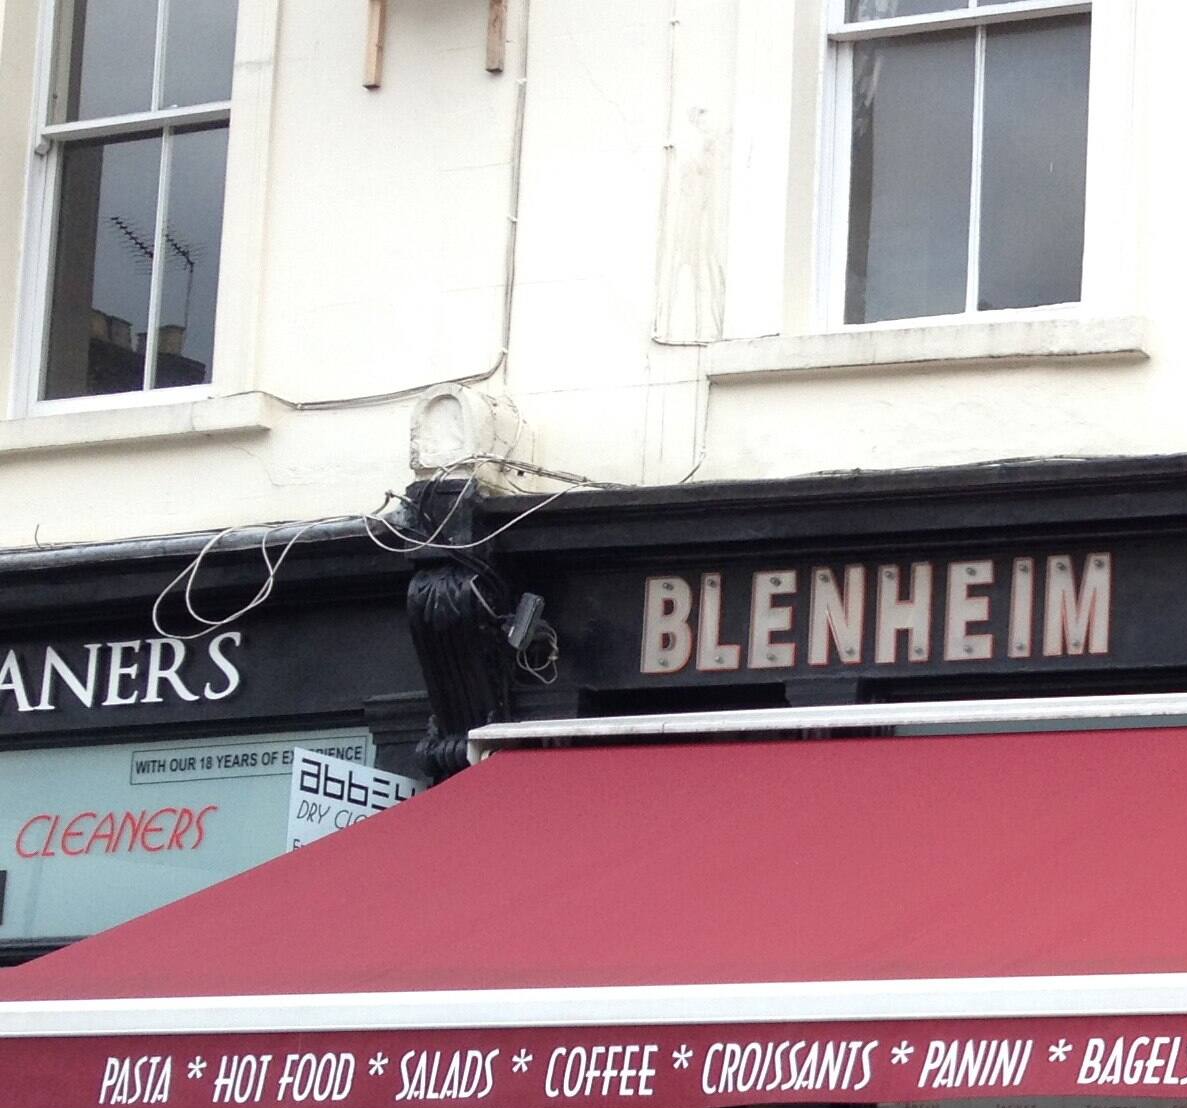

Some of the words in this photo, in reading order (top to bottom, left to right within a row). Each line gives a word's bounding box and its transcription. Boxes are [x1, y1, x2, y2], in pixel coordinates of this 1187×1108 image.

[640, 551, 1112, 673] BLENHEIM
[0, 631, 241, 712] ANERS
[136, 760, 166, 775] WITH
[169, 757, 196, 771] OUR
[200, 756, 213, 770] 18
[217, 754, 258, 769] YEARS
[261, 752, 278, 767] OF
[15, 805, 218, 858] CLEANERS
[296, 799, 331, 824] DRY
[98, 1056, 172, 1105] PASTA
[212, 1054, 273, 1104] HOT
[277, 1053, 355, 1103] FOOD
[395, 1048, 499, 1101] SALADS
[544, 1044, 659, 1098] COFFEE
[701, 1040, 879, 1095] CROISSANTS
[917, 1039, 1034, 1089] PANINI
